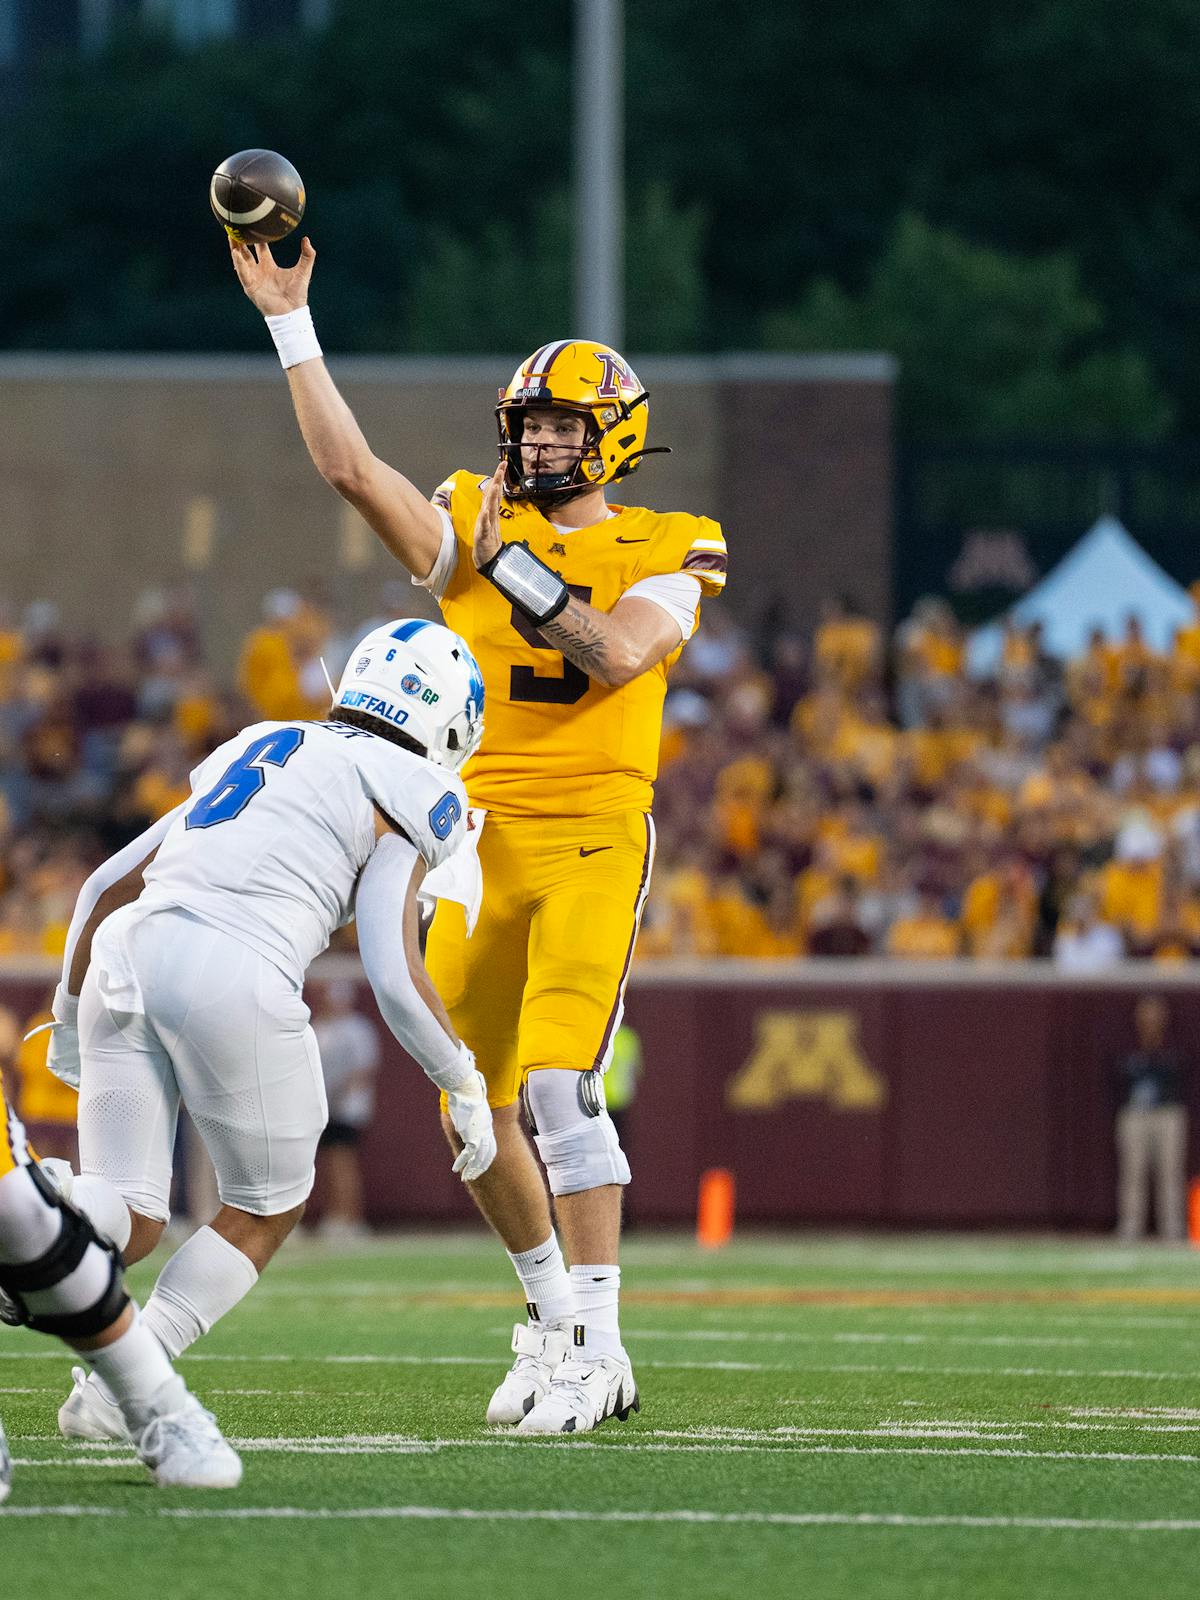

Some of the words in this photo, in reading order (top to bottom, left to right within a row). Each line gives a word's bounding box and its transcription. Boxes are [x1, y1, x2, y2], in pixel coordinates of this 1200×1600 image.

[522, 387, 541, 397] ROW
[385, 648, 397, 662] 6
[340, 690, 410, 726] BUFFALO
[420, 687, 440, 706] GP
[185, 727, 305, 832] 6
[428, 790, 462, 842] 6
